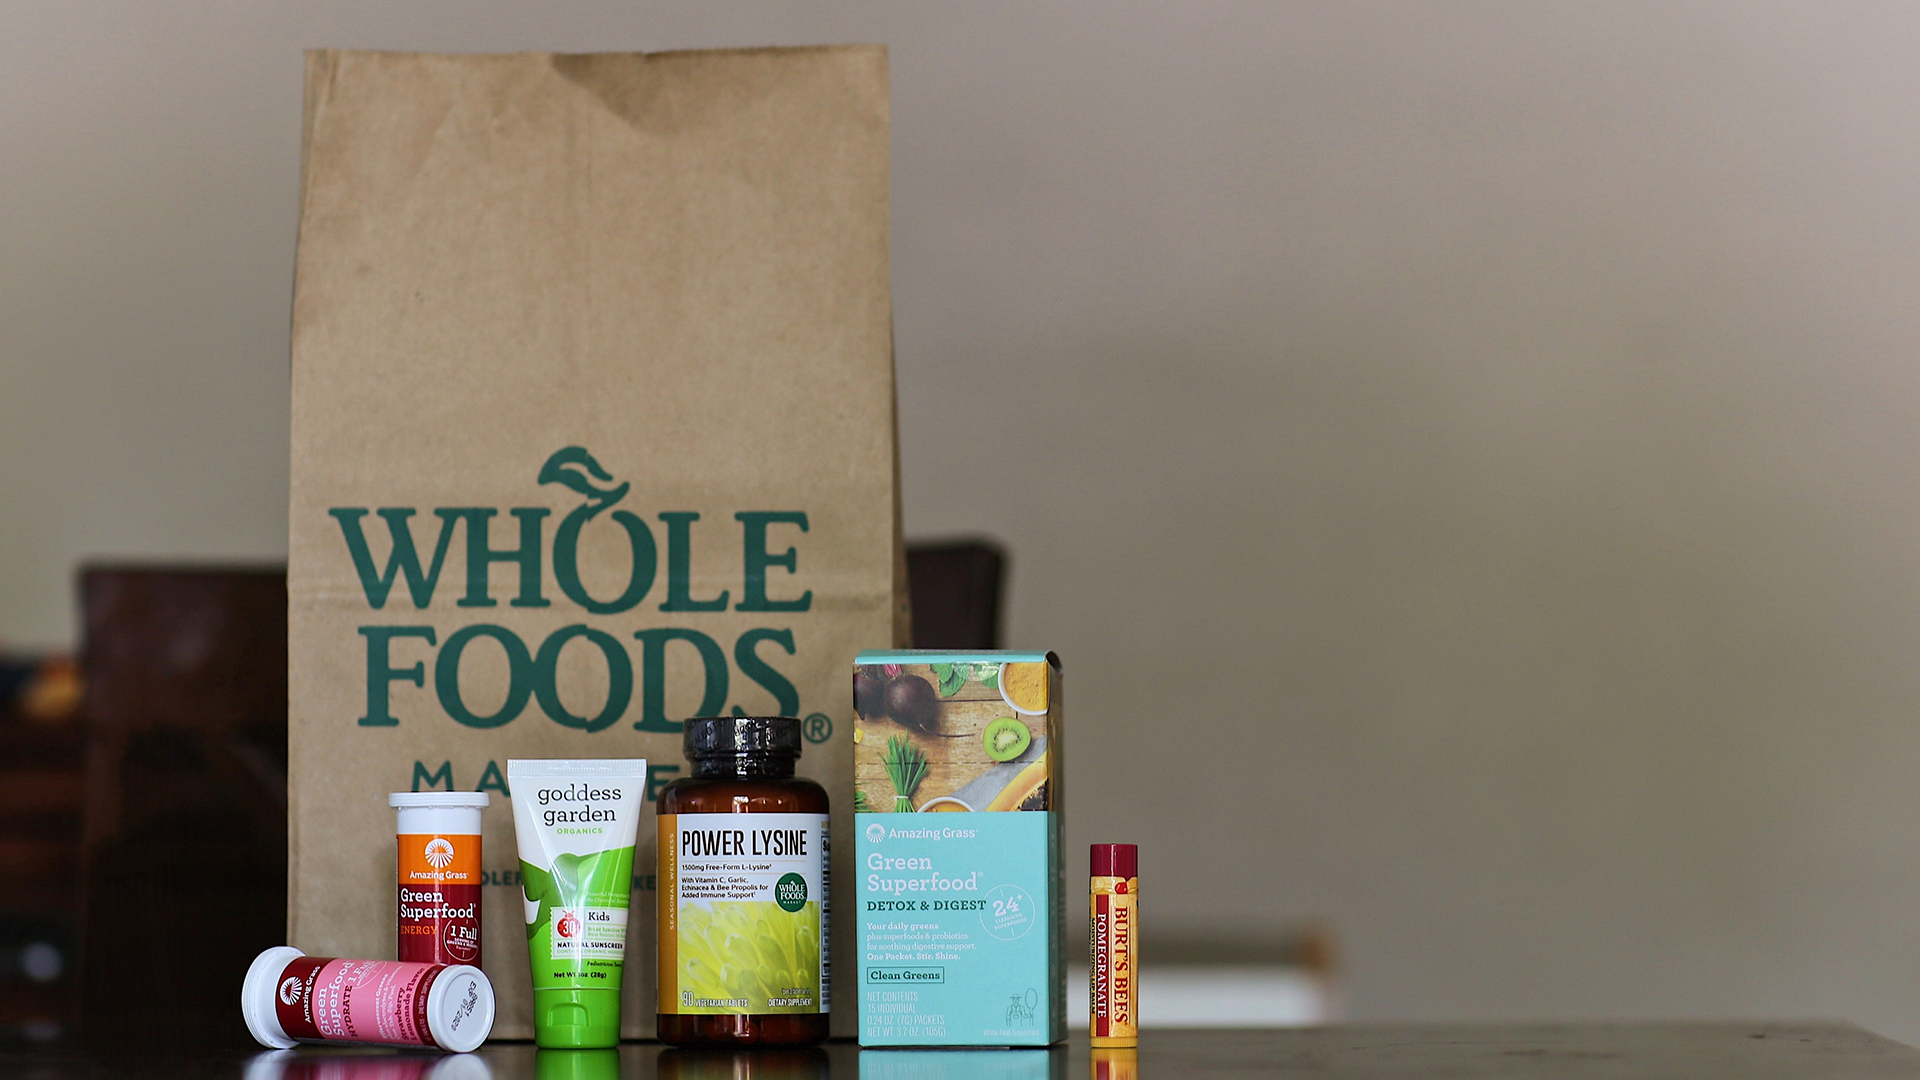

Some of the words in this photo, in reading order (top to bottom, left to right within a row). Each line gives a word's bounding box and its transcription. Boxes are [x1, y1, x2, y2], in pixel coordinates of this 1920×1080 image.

[328, 500, 813, 615] WHOLE
[357, 624, 799, 733] FOODS
[538, 784, 622, 805] goddess
[543, 805, 616, 826] garden
[888, 828, 940, 841] Amazing
[942, 827, 976, 838] Grass
[682, 830, 745, 856] POWER
[752, 829, 807, 856] LYSINE
[867, 852, 932, 870] Green
[410, 871, 444, 881] Amazing
[445, 870, 468, 879] Grass
[778, 883, 805, 892] WHOLE
[401, 888, 443, 902] Green
[780, 892, 805, 900] FOODS
[867, 900, 916, 911] DETOX
[920, 900, 929, 910] &
[934, 900, 986, 910] DIGEST
[588, 912, 610, 922] Kids
[401, 925, 438, 935] ENERGY
[450, 926, 457, 937] 1
[459, 925, 478, 941] Full
[563, 921, 577, 935] 30
[888, 922, 909, 931] daily
[867, 933, 882, 941] plus
[883, 932, 924, 940] superfoods
[931, 932, 968, 941] probiotics
[867, 942, 877, 950] for
[878, 942, 910, 951] soothing
[911, 942, 944, 951] digestive
[946, 943, 976, 951] support.
[885, 952, 915, 960] Packet.
[917, 952, 934, 960] Stir.
[935, 952, 960, 960] Shine.
[1096, 913, 1107, 1018] POMEGRANATE
[305, 966, 320, 986] Grass
[406, 967, 425, 992] Flavor
[870, 971, 900, 980] Clean
[903, 971, 940, 980] Greens
[682, 991, 694, 1007] 90
[725, 998, 748, 1007] TABLETS
[867, 992, 881, 1001] NET
[882, 991, 918, 1001] CONTENTS
[1114, 978, 1129, 1026] BEES
[303, 986, 312, 1023] Amazing
[318, 987, 332, 1035] Green
[343, 985, 358, 1037] HYDRATE
[868, 1003, 876, 1013] 15
[877, 1003, 916, 1013] INDIVIDUAL
[395, 987, 409, 1040] Strawberry
[403, 994, 418, 1040] Lemonade
[867, 1015, 882, 1025] 0.24
[897, 1015, 913, 1026] (7G)
[914, 1015, 945, 1025] PACKETS
[867, 1027, 881, 1037] NET
[897, 1027, 907, 1036] 3.7
[922, 1026, 946, 1038] (105G)
